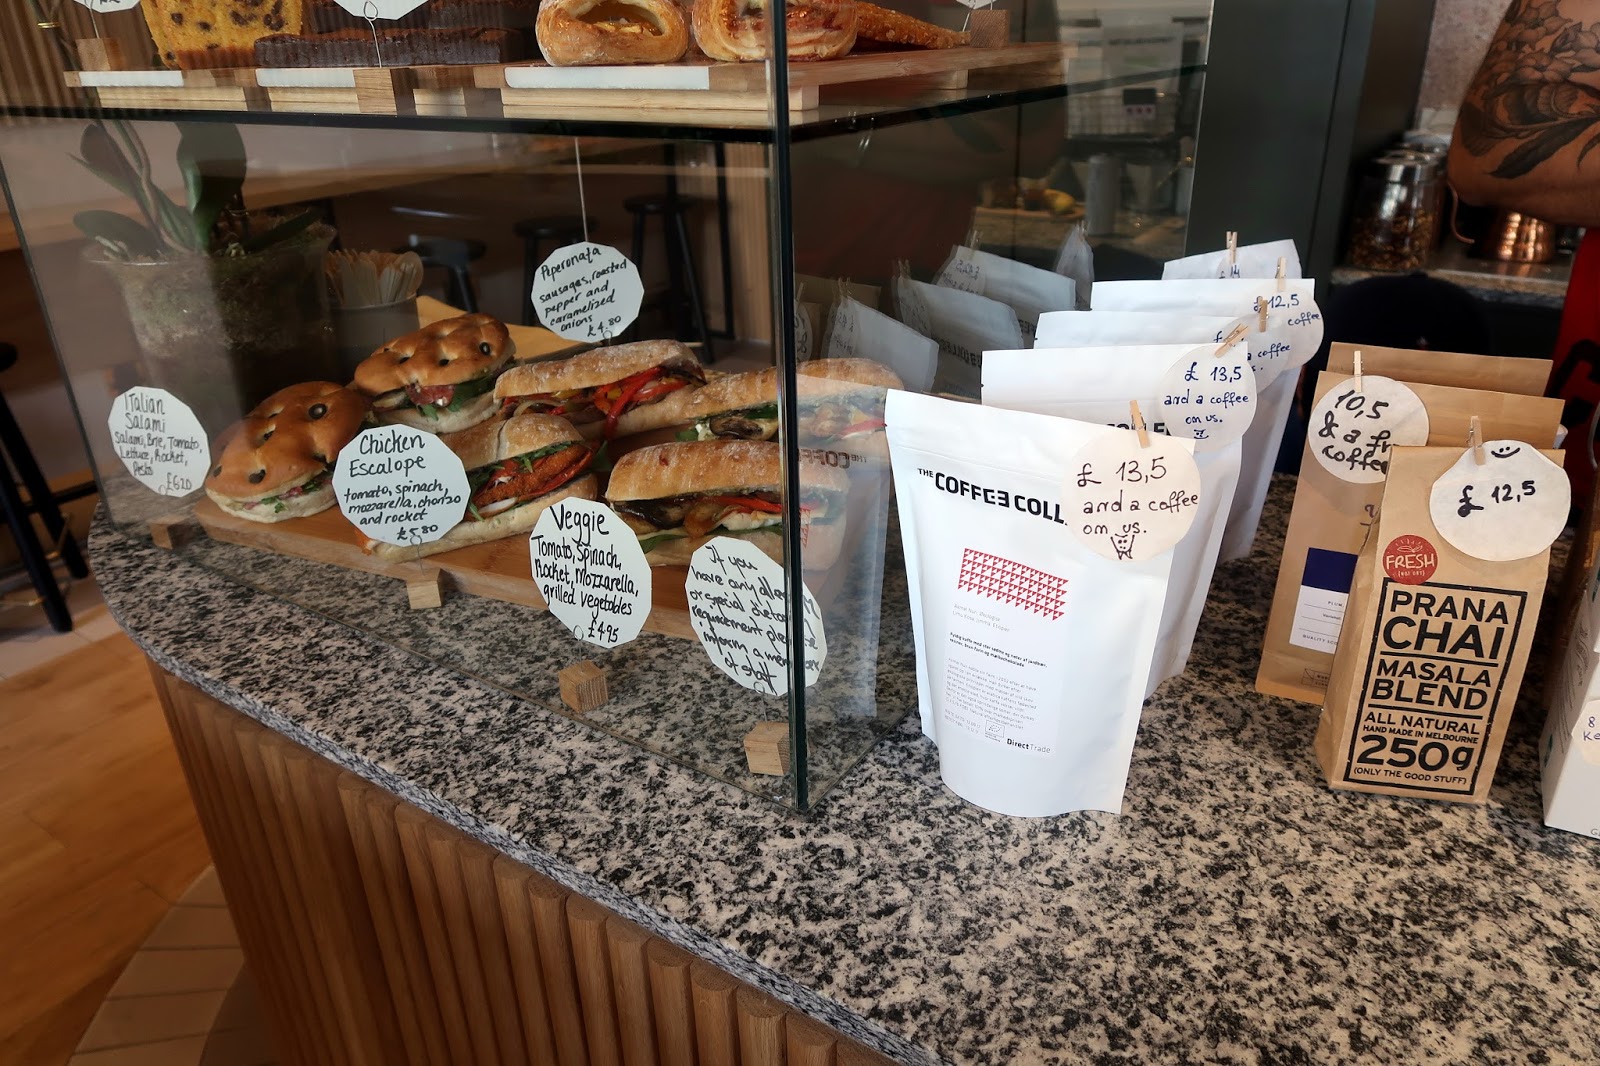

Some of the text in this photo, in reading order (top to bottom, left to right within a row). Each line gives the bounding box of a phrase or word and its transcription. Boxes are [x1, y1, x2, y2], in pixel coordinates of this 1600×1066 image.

[592, 258, 627, 280] roasted
[545, 280, 608, 318] pepper and
[550, 288, 615, 326] caramelized
[560, 315, 593, 332] onions
[1288, 312, 1320, 326] coffee
[1257, 343, 1291, 359] coffee
[1184, 361, 1242, 383] £ 13,5
[1163, 388, 1249, 409] and a coffee
[1334, 389, 1389, 419] 10,5
[1318, 410, 1339, 439] &
[1343, 429, 1361, 443] a
[360, 429, 425, 455] Chicken
[350, 455, 426, 477] Escalope
[1077, 456, 1167, 487] £ 13,5
[344, 478, 449, 503] tomato, spinach,
[917, 468, 934, 479] THE
[934, 472, 1010, 508] COFFEE
[1457, 480, 1536, 518] £ 12,5
[1083, 489, 1199, 514] and a coffee
[360, 508, 428, 525] and rocket
[549, 504, 610, 547] Veggie
[1122, 522, 1148, 534] us.
[531, 535, 622, 571] Tomato, Spinach,
[1386, 554, 1435, 570] FRESH
[535, 558, 574, 589] Rocket,
[728, 555, 758, 579] you
[543, 583, 577, 607] grilled
[691, 565, 724, 586] have
[728, 579, 763, 606] any
[690, 589, 703, 601] or
[705, 592, 745, 618] special
[1390, 590, 1509, 625] PRANA
[1382, 616, 1506, 660] CHAI
[753, 648, 764, 659] a
[724, 651, 777, 696] of staff
[1376, 658, 1492, 688] MASALA
[1370, 678, 1489, 711] BLEND
[1363, 724, 1387, 733] HAND
[1388, 727, 1413, 737] MADE
[1426, 730, 1479, 744] MELBOURNE
[1364, 711, 1480, 735] ALL NATURAL
[1357, 734, 1475, 772] 250g
[1353, 766, 1467, 785] (ONLY THE GOOD STUFF)
